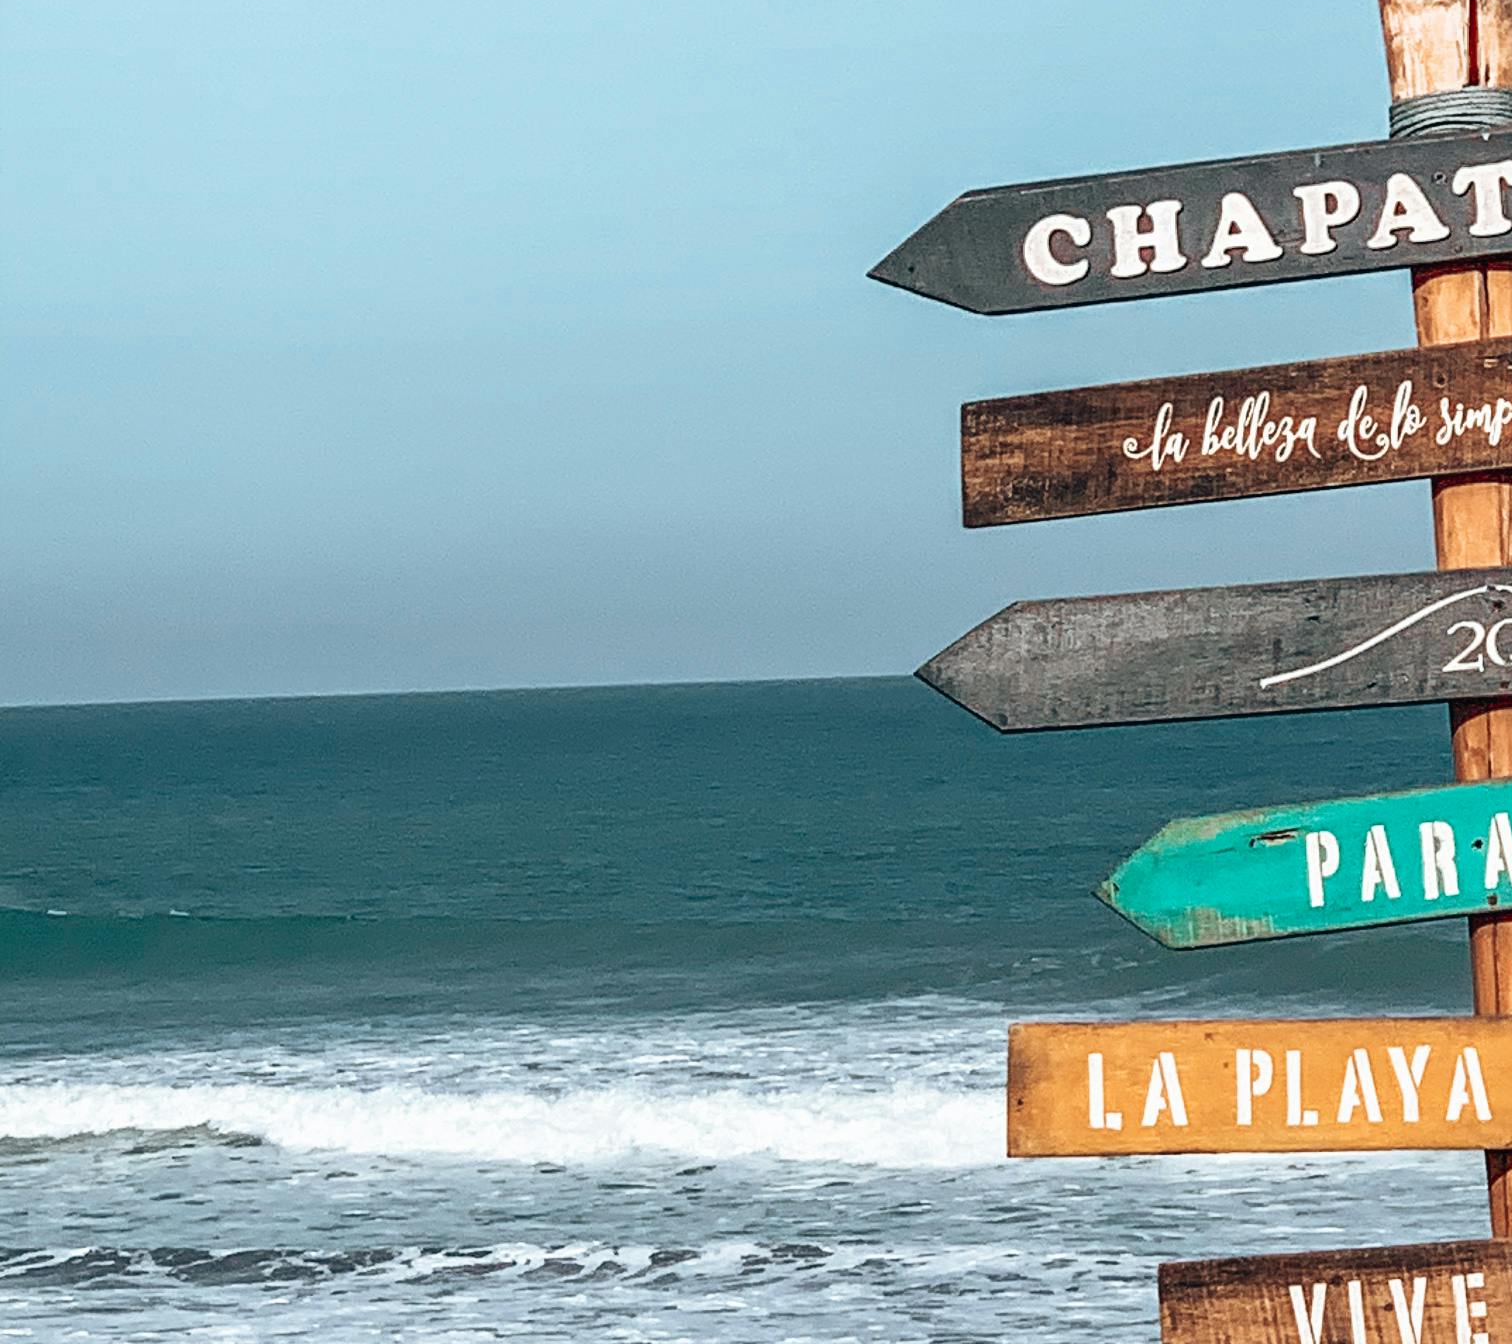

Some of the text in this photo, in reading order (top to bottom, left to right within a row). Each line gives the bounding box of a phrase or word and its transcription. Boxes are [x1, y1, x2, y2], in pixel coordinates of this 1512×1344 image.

[1122, 401, 1191, 472] la
[1200, 390, 1322, 463] belleza
[1336, 384, 1391, 461] de
[1389, 379, 1428, 451] lo
[1086, 1051, 1189, 1132] LA
[1234, 1043, 1493, 1127] PLAYA
